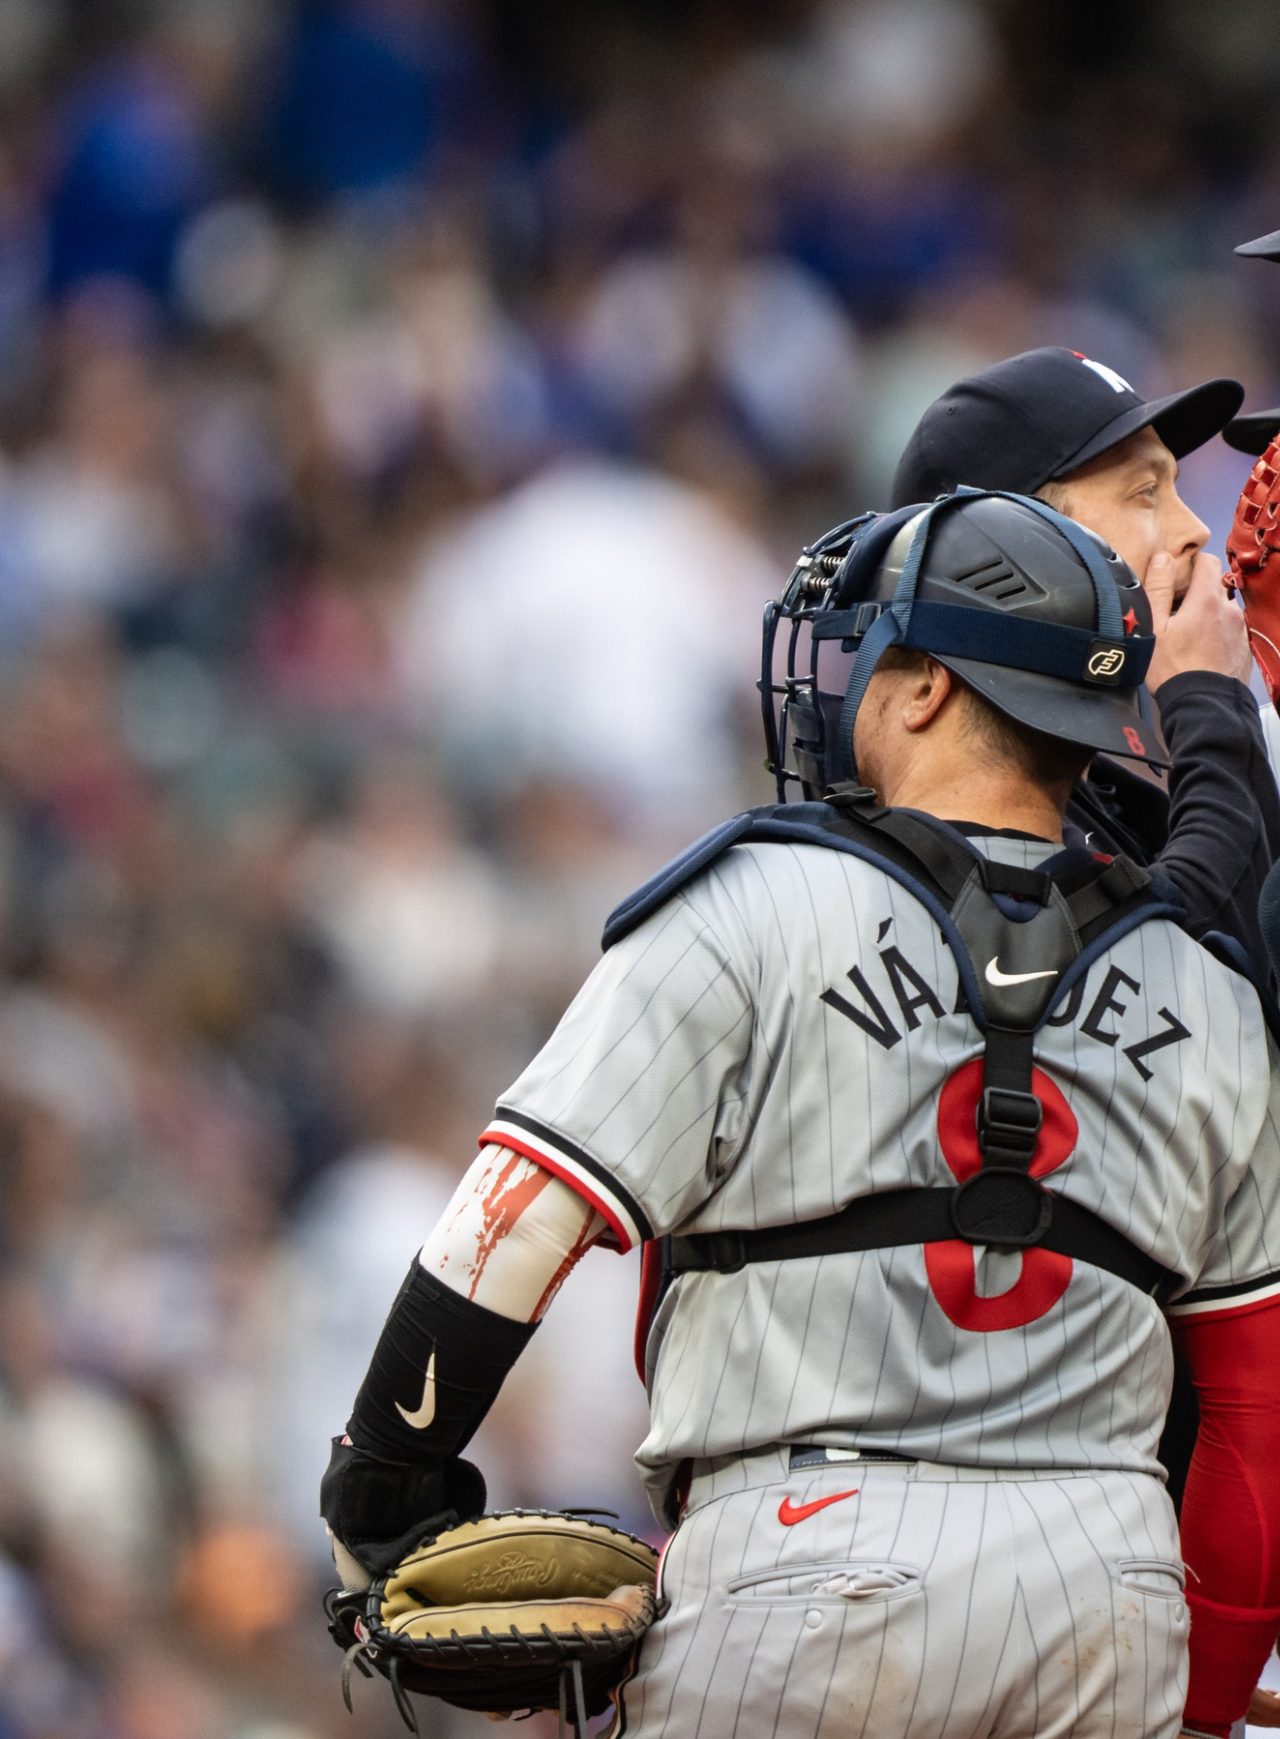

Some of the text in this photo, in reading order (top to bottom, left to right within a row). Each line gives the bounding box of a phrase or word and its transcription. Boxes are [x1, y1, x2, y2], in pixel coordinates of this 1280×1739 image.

[1122, 726, 1146, 756] 8
[819, 916, 1192, 1082] VÁEZ
[923, 1056, 1079, 1332] 8
